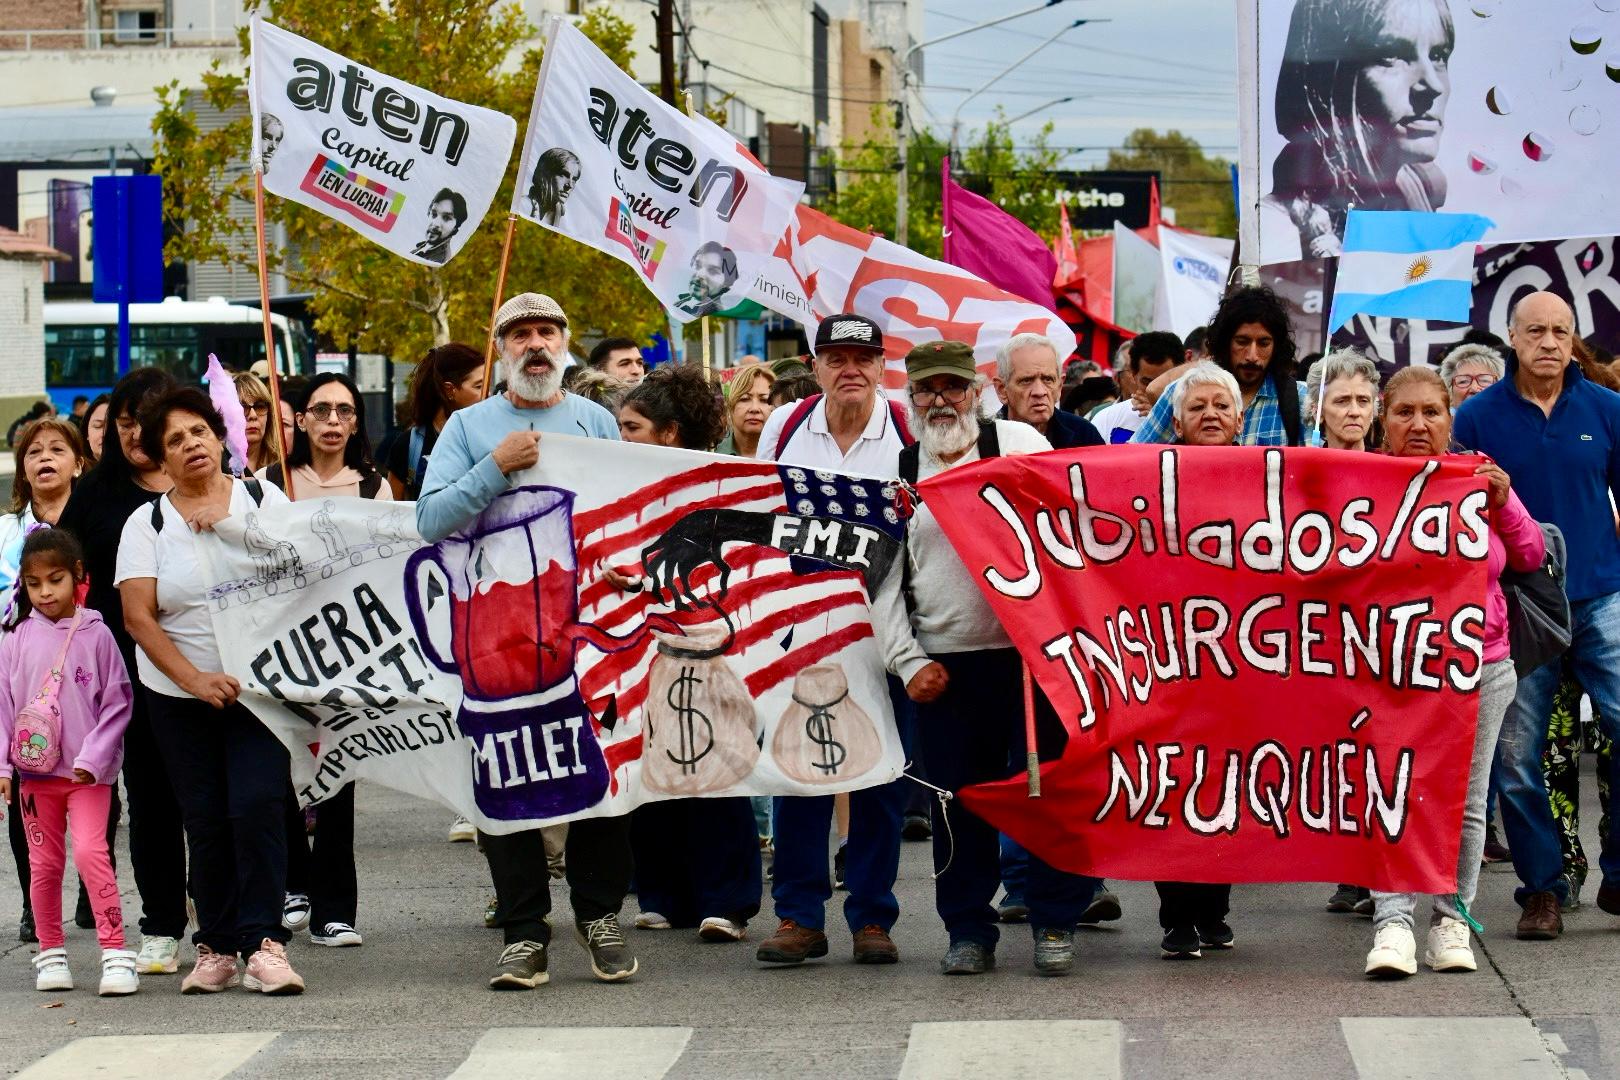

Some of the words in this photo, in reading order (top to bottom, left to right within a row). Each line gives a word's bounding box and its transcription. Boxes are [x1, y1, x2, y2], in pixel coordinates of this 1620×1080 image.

[286, 57, 470, 167] aten
[321, 127, 415, 181] Capital
[587, 87, 749, 223] aten
[318, 170, 345, 194] ¡EN
[341, 184, 389, 218] LUCHA!
[979, 448, 1488, 599] Jubilados/as
[1045, 595, 1486, 731] INSURGENTES
[465, 716, 587, 789] MILEI
[1094, 707, 1414, 843] NEUQUÉN
